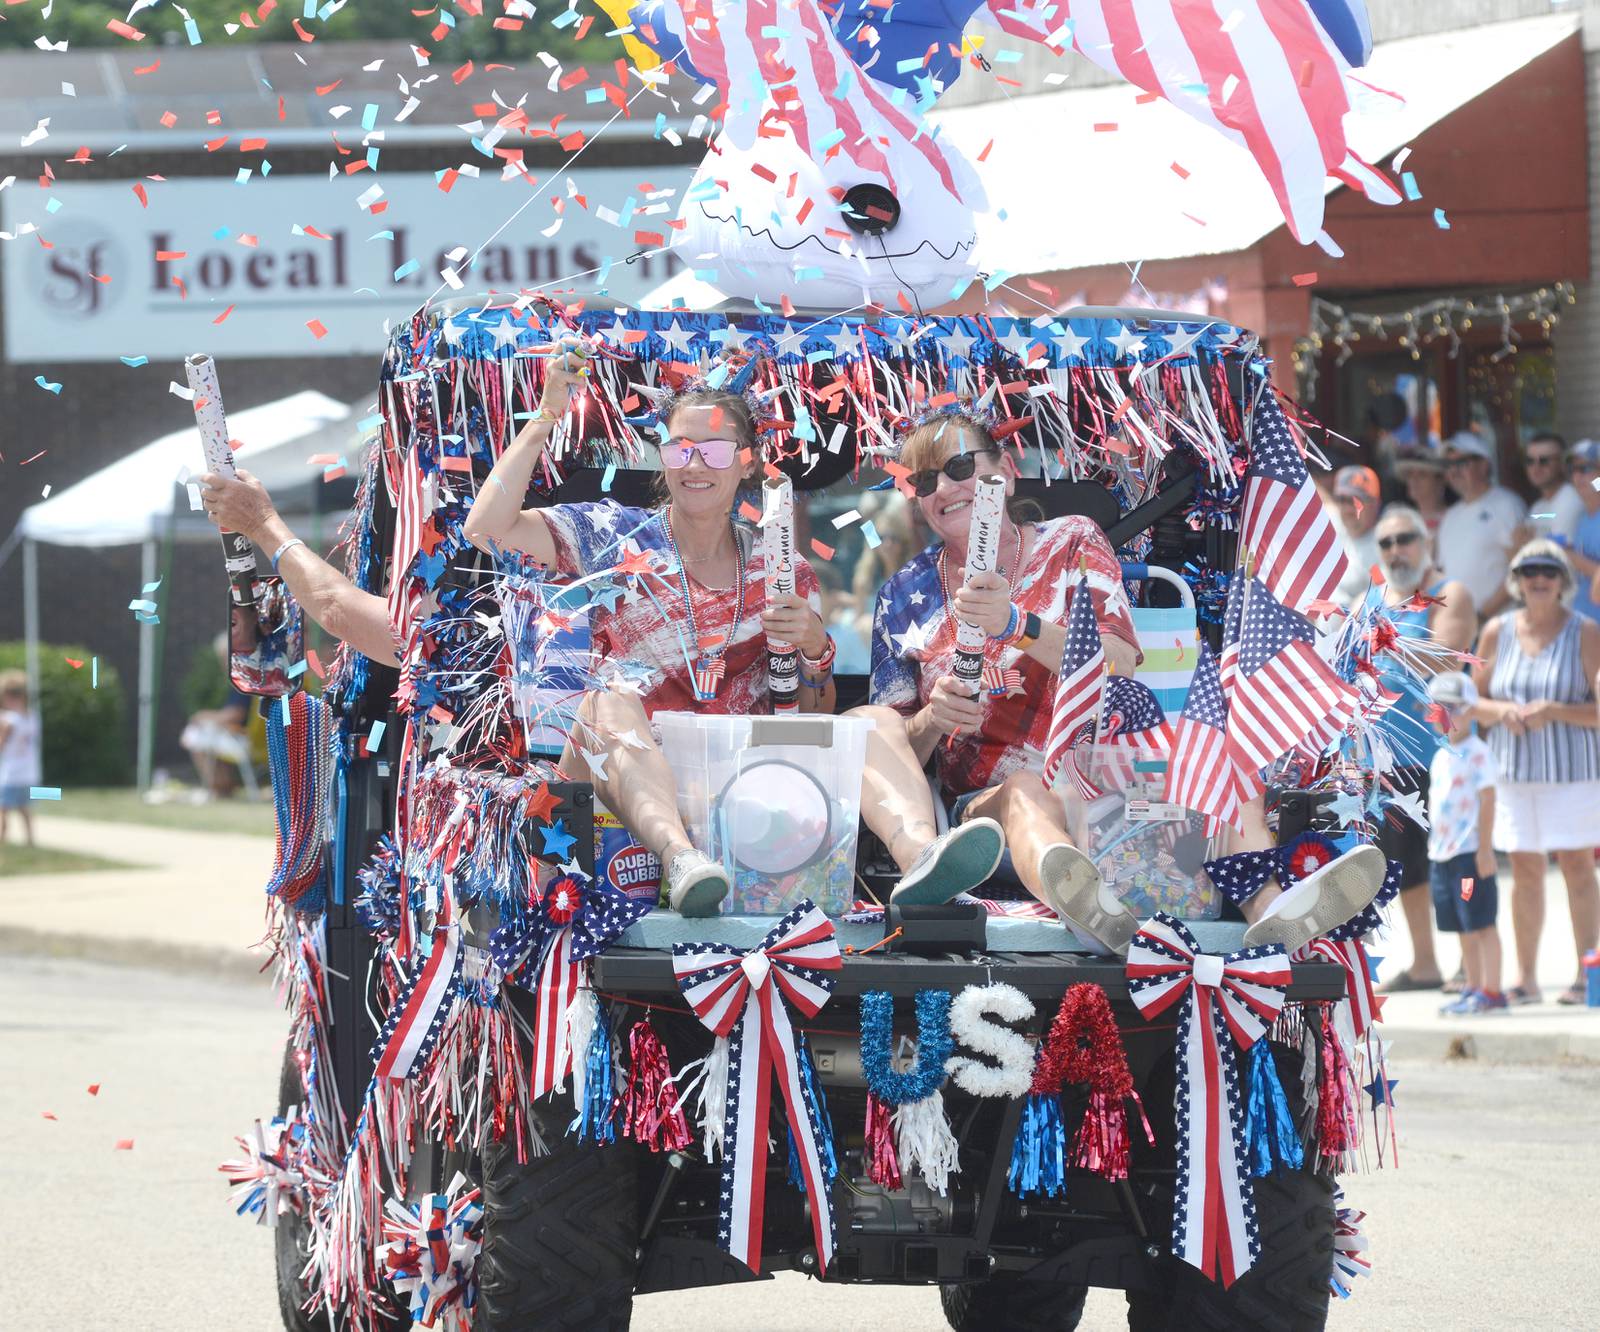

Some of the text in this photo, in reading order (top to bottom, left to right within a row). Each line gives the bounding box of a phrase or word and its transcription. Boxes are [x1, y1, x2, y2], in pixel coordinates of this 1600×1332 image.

[149, 229, 348, 294] Local
[388, 225, 599, 287] Loans
[777, 526, 792, 573] Cannon
[971, 521, 989, 571] Cannon
[614, 853, 661, 872] DUBBL
[618, 866, 662, 886] BUBBL
[860, 981, 1134, 1104] USA
